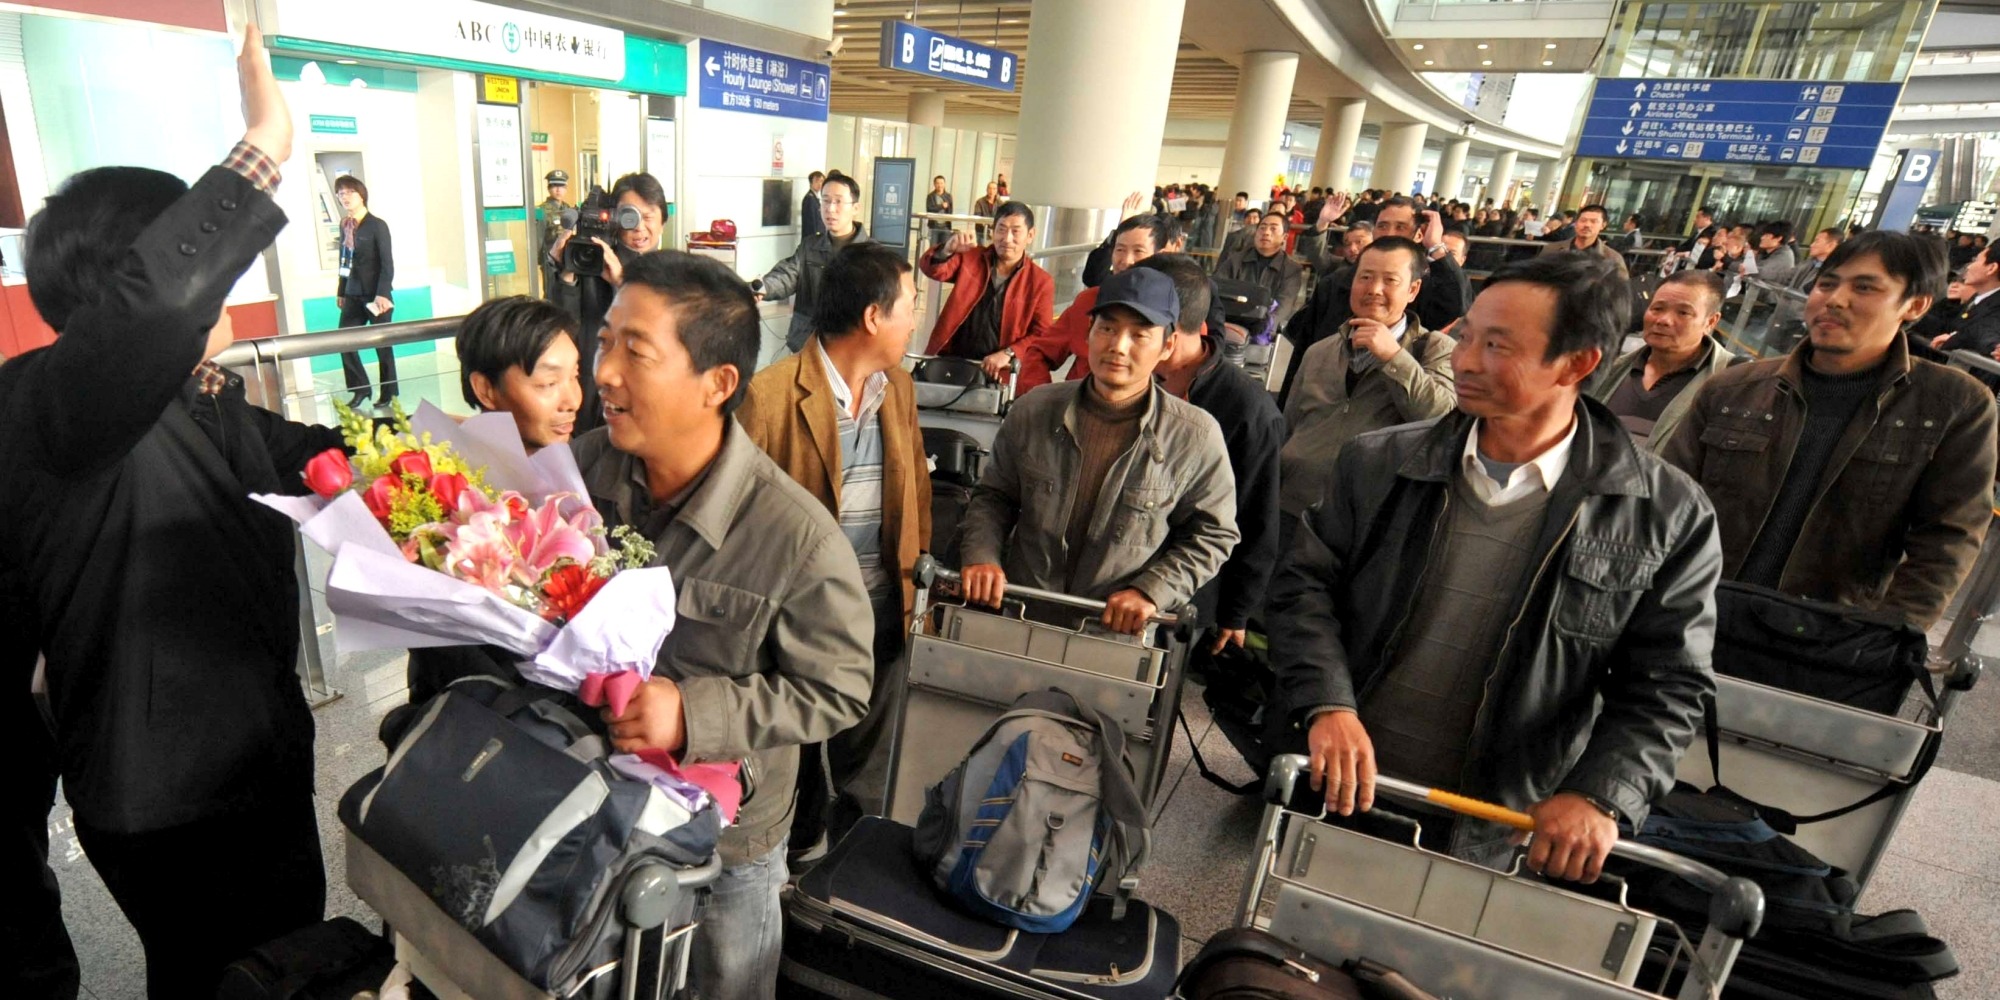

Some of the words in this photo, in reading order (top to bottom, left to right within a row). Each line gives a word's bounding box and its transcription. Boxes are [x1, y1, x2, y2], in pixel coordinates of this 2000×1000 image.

[455, 20, 495, 43] ABC
[523, 26, 607, 60] 中国农业银行
[902, 32, 915, 64] B
[1000, 56, 1012, 83] B
[722, 69, 746, 90] Hourly
[1650, 91, 1685, 99] Check-in
[1825, 87, 1841, 97] 4F
[1647, 102, 1716, 112] 航空公司办公室
[1644, 110, 1674, 119] Airlines
[1674, 111, 1699, 119] Office
[1817, 108, 1834, 117] 3F
[1637, 129, 1657, 138] Free
[1657, 130, 1688, 139] Shuttle
[1688, 131, 1705, 140] Bus
[1716, 132, 1755, 141] Terminal
[1764, 134, 1772, 142] 2
[1634, 140, 1662, 149] 出租车
[1728, 144, 1768, 154] 机场巴士
[1632, 148, 1648, 156] Taxi
[1725, 152, 1754, 161] Shuttle
[1754, 153, 1771, 161] Bus
[1904, 154, 1932, 182] B
